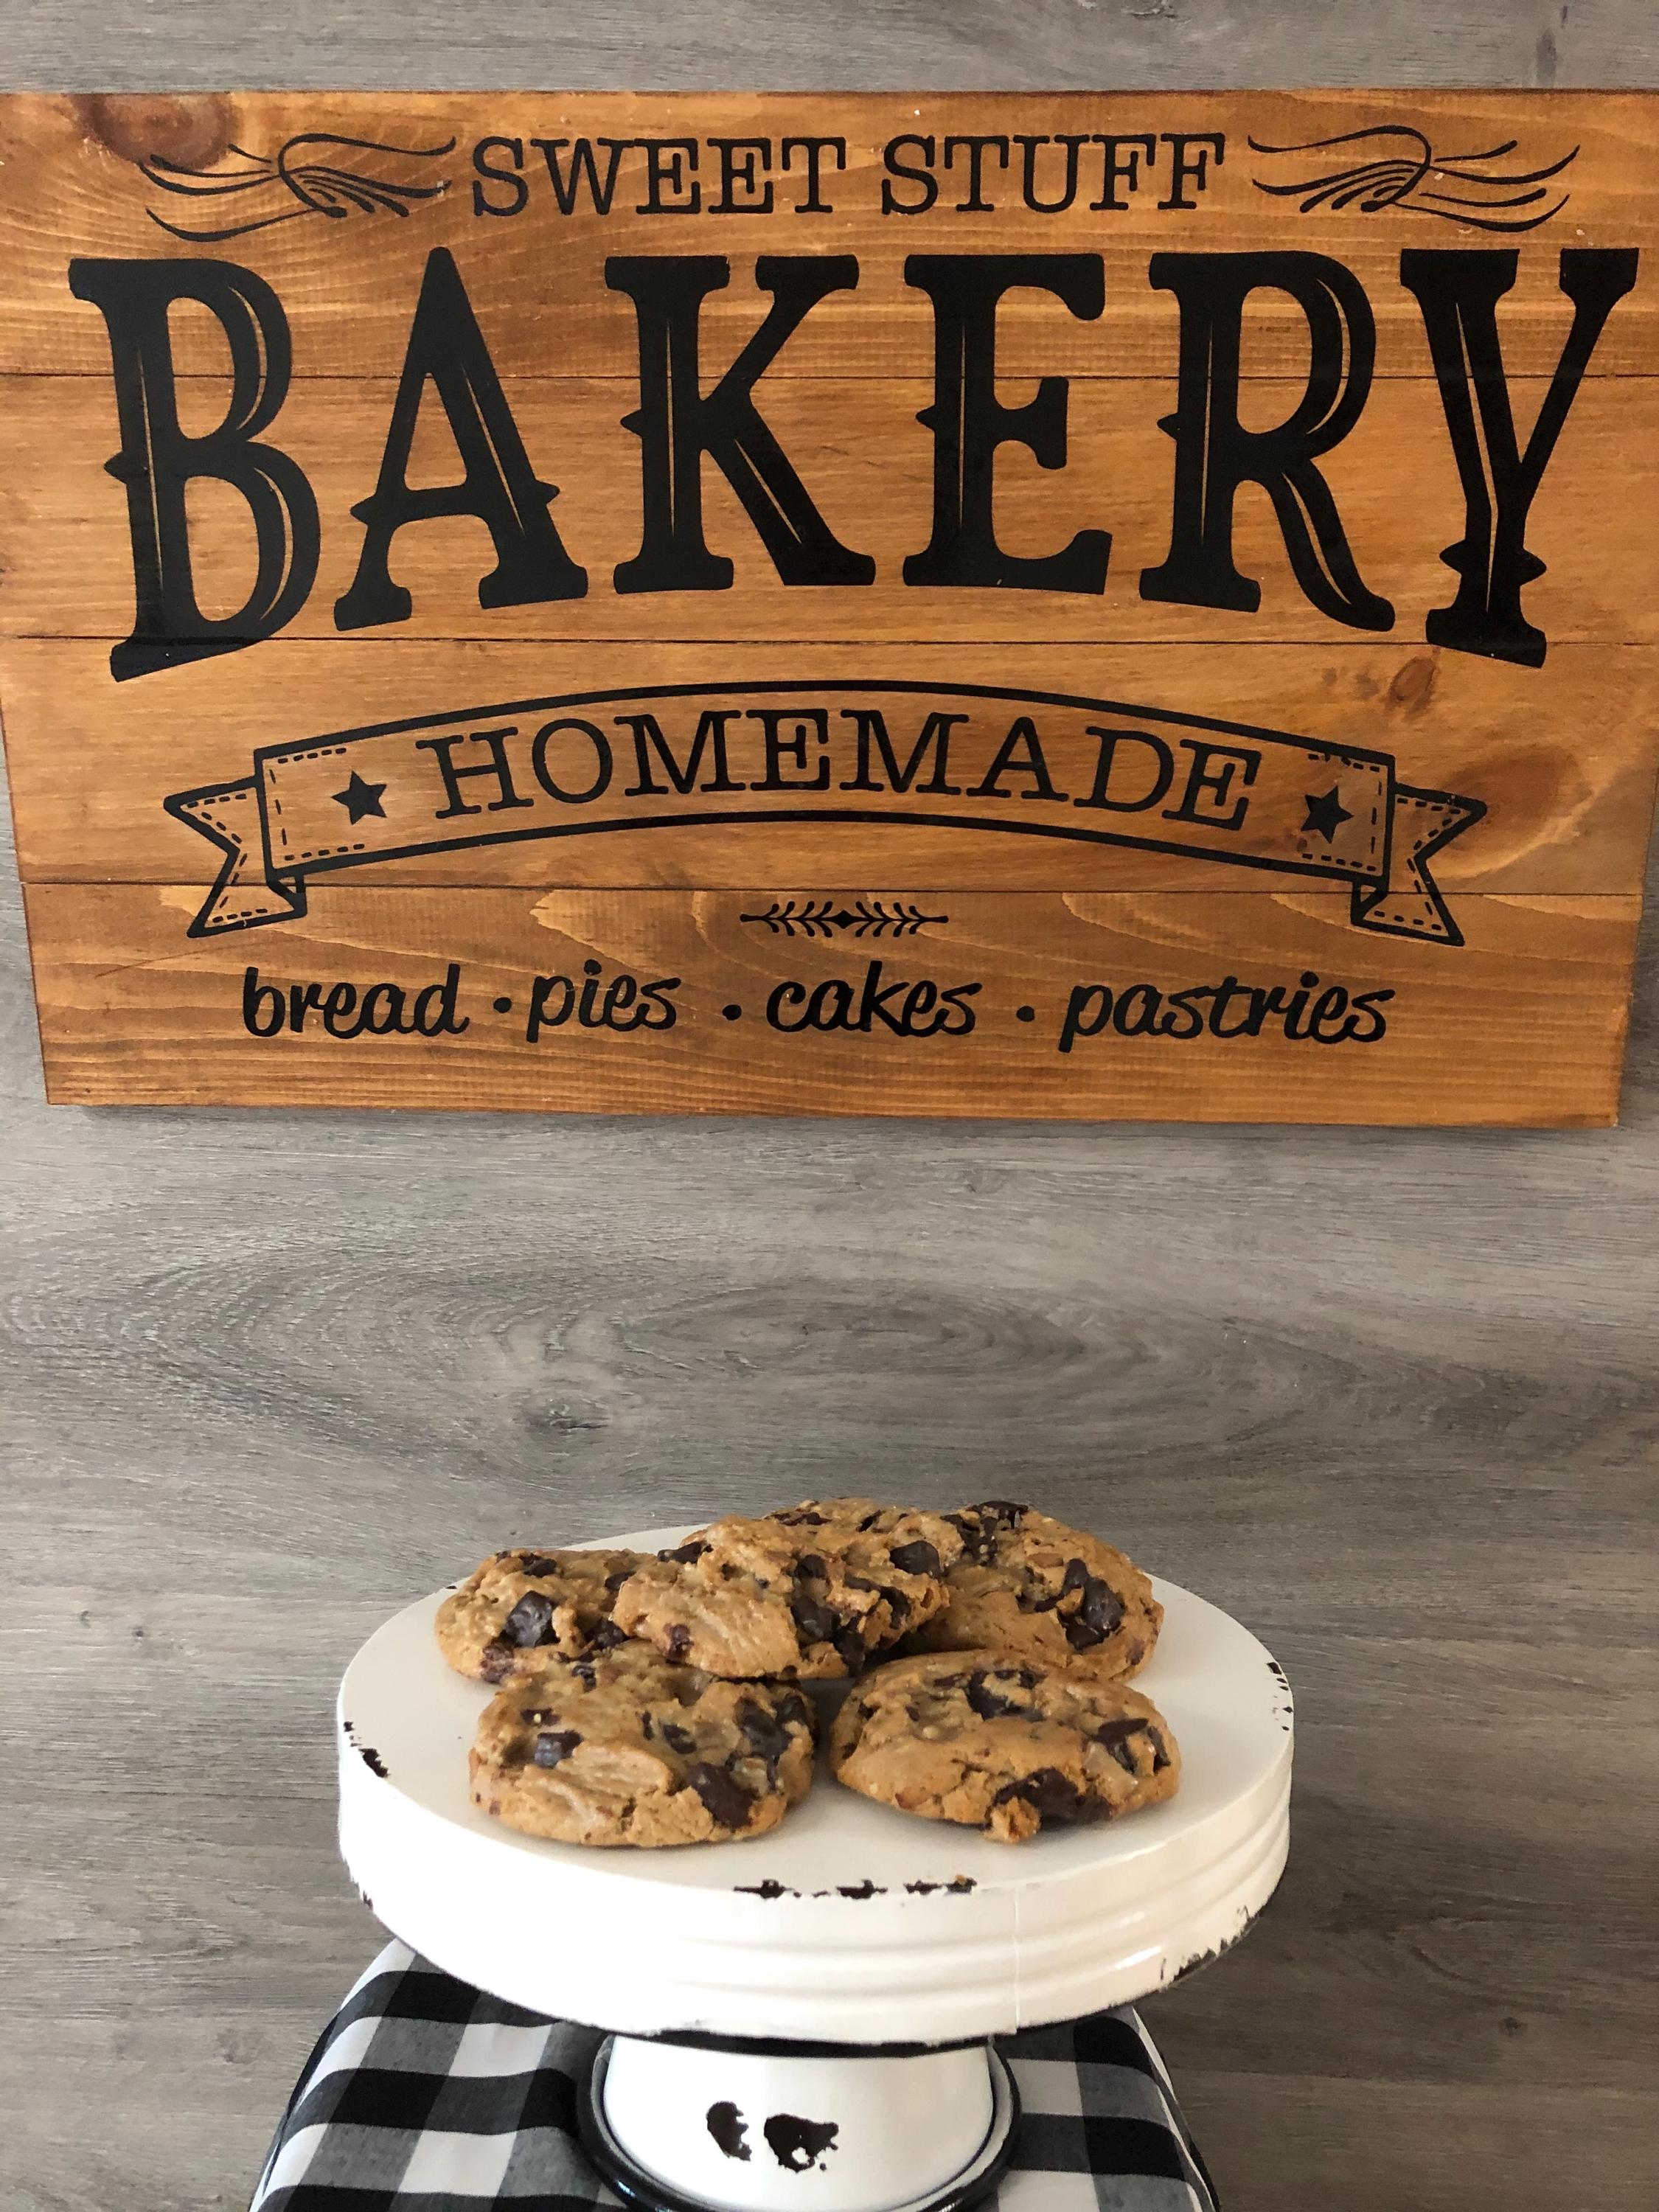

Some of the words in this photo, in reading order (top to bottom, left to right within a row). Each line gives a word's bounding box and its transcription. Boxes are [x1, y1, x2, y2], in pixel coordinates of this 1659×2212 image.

[472, 136, 847, 217] SWEET
[882, 133, 1226, 215] STUFF
[68, 247, 1640, 686] BAKERY
[416, 708, 1262, 831] HOMEMADE
[243, 964, 470, 1040] bread
[526, 959, 682, 1043] pies
[765, 960, 984, 1038] cakes
[1057, 971, 1397, 1054] pastries
